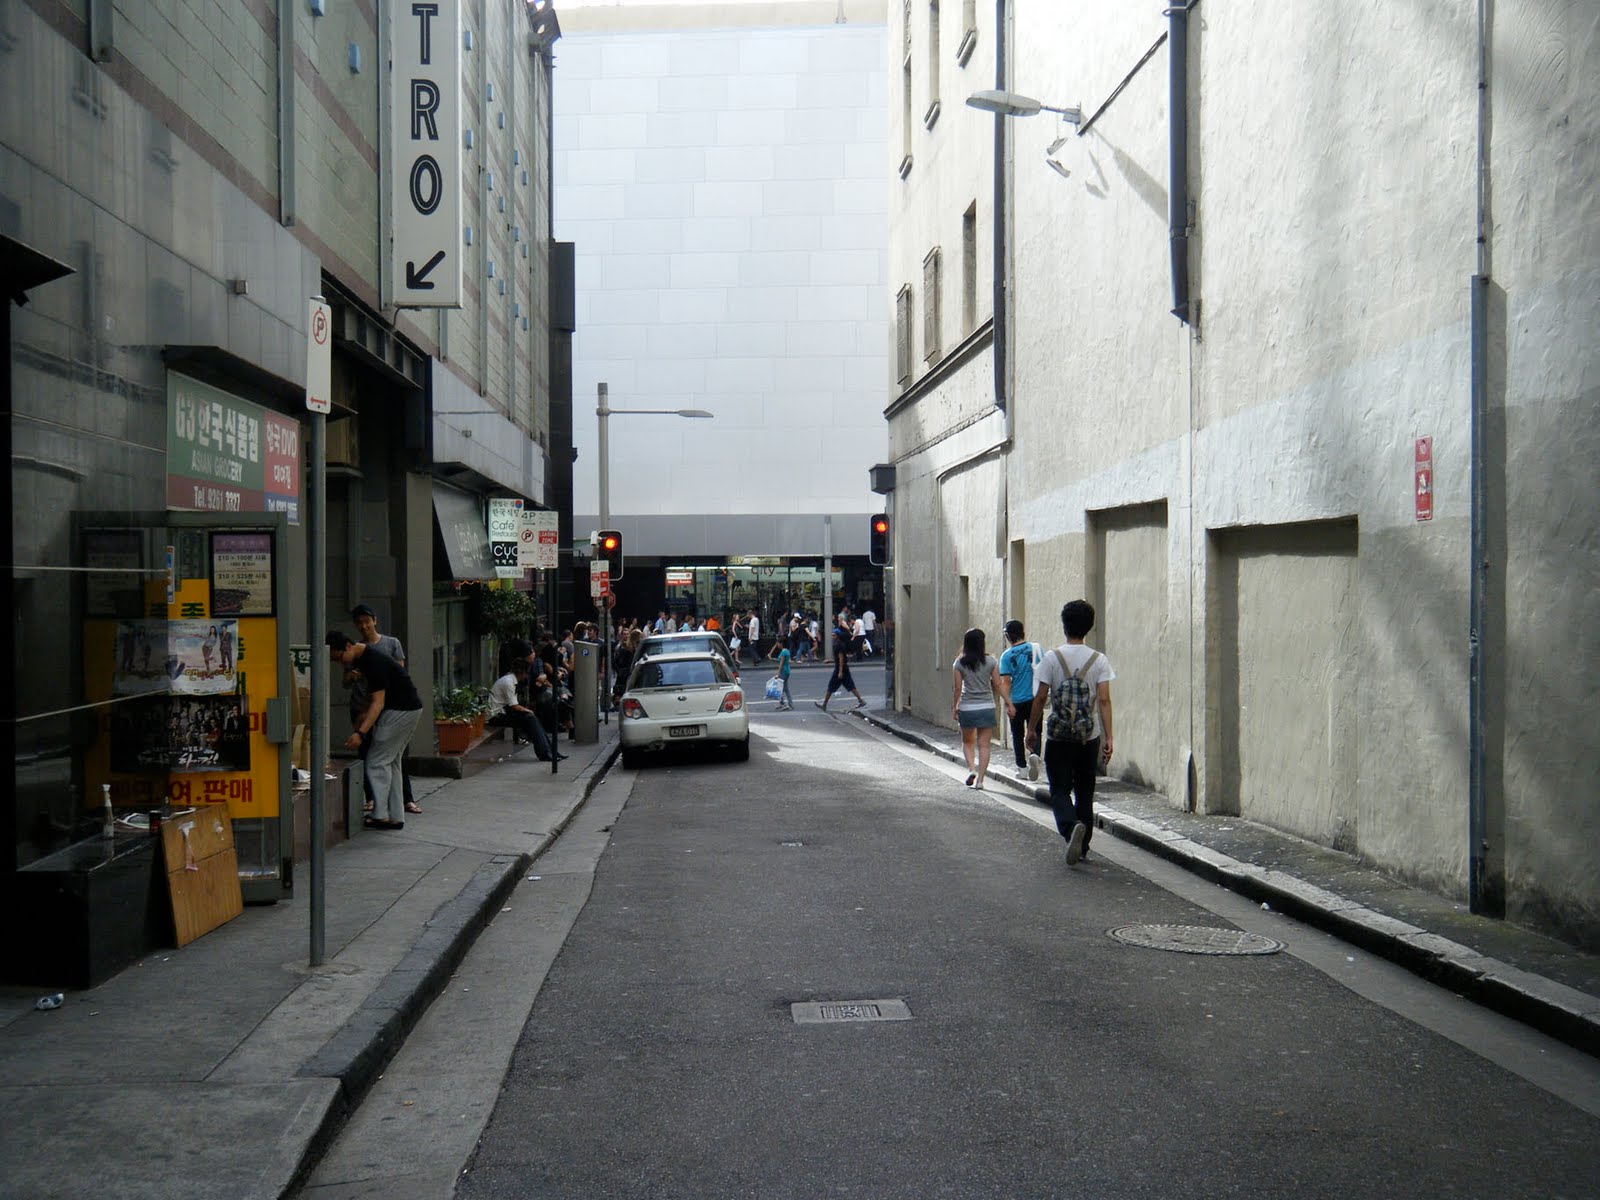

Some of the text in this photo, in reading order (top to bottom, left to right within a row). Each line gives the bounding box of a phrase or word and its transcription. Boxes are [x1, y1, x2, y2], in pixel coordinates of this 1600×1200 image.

[175, 391, 259, 463] G3 한국식품점
[281, 428, 298, 459] DVD
[214, 456, 243, 483] GROCERY
[521, 511, 536, 519] 4P
